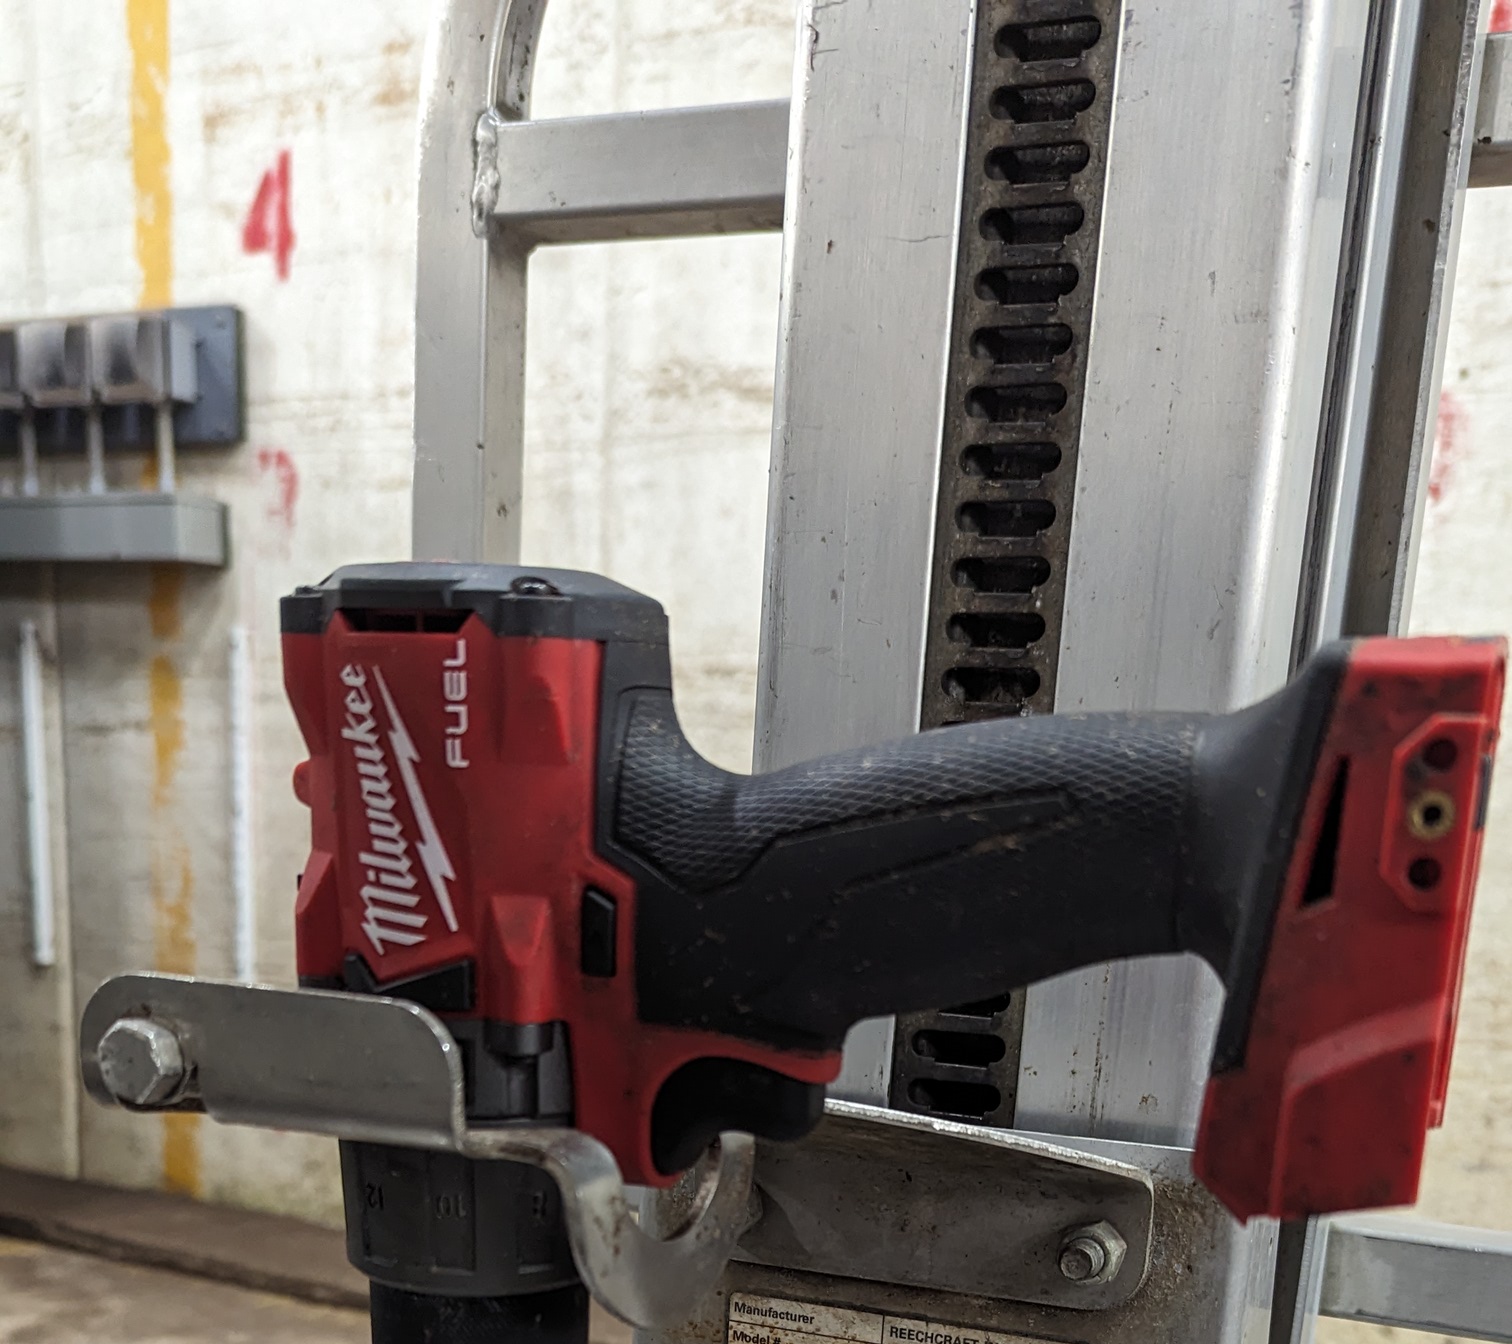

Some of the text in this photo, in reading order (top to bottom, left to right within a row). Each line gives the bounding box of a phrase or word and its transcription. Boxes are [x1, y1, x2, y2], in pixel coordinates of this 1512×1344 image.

[242, 150, 295, 282] 4
[444, 638, 470, 769] FUEL
[340, 663, 429, 956] Milwaukee
[734, 1301, 815, 1325] Manufacturer
